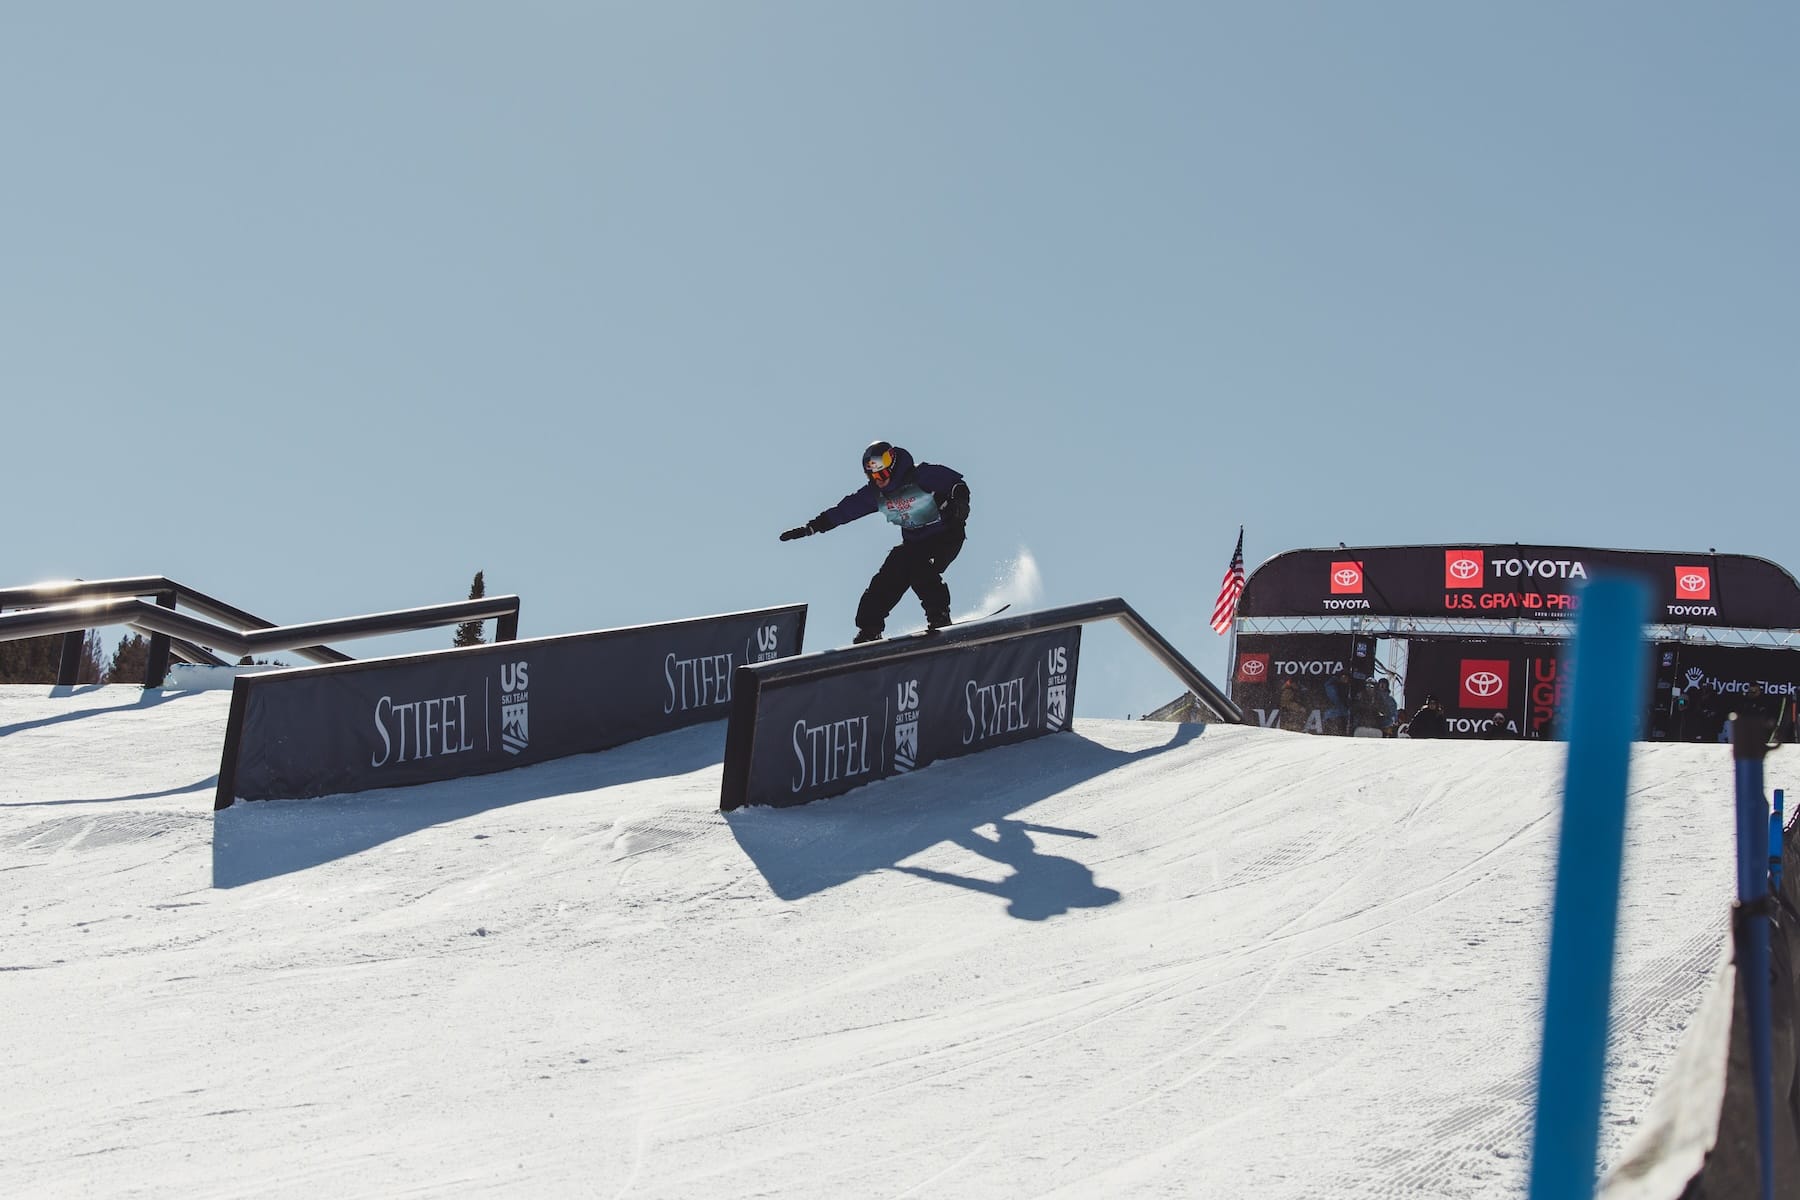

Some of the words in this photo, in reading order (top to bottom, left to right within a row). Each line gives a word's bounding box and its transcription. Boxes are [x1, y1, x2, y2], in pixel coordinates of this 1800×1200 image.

[1491, 559, 1588, 579] TOYOTA
[1323, 600, 1370, 609] TOYOTA
[1445, 594, 1476, 609] U.S.
[1480, 593, 1542, 609] GRAND
[1546, 594, 1580, 610] PRI
[1667, 605, 1717, 616] TOYOTA
[757, 625, 777, 652] US
[1049, 646, 1067, 675] US
[1275, 661, 1344, 675] TOYOTA
[501, 661, 528, 693] US
[1055, 675, 1067, 684] TEAM
[502, 695, 512, 705] SKI
[513, 691, 528, 702] TEAM
[898, 680, 919, 711] US
[896, 714, 904, 724] SKI
[904, 711, 919, 722] TEAM
[963, 677, 1029, 745] STIFEL
[371, 694, 473, 767] STIFEL
[1446, 718, 1518, 734] TOYOA
[792, 716, 870, 792] STIFEL
